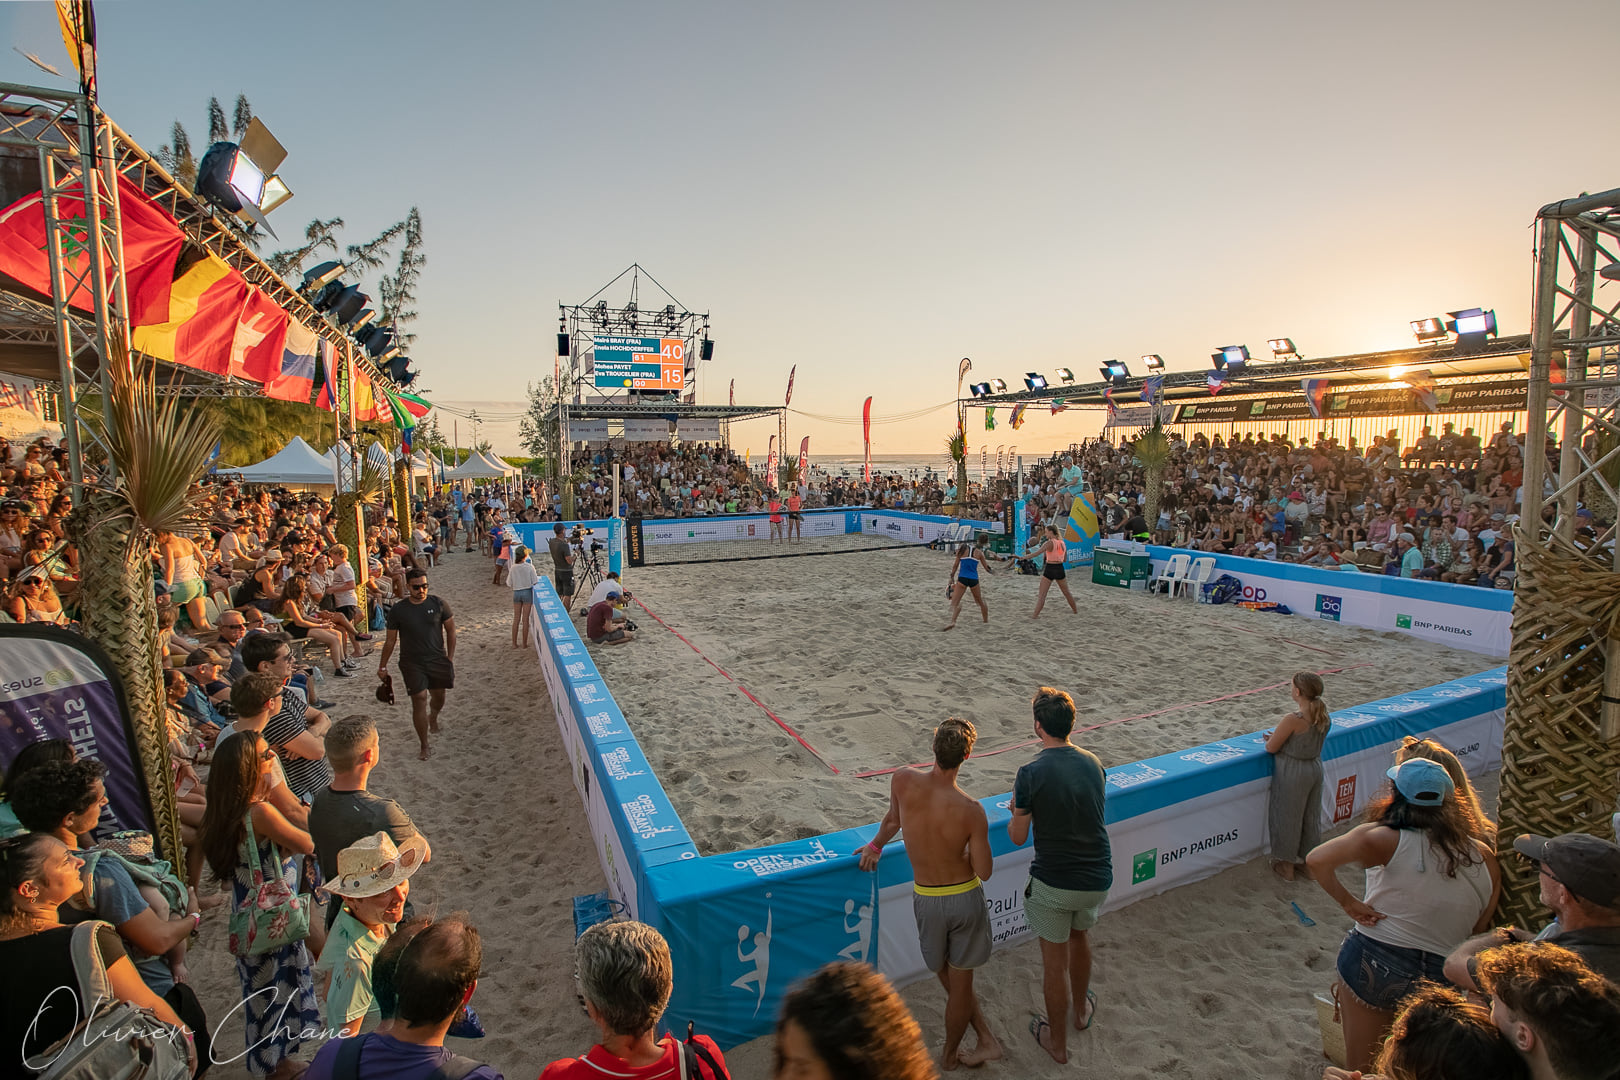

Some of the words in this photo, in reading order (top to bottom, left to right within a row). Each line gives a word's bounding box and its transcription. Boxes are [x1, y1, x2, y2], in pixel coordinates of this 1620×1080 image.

[661, 345, 683, 360] 40
[663, 369, 681, 383] 15
[1369, 394, 1409, 404] PARIBAS
[1454, 391, 1477, 399] BNP
[1478, 387, 1528, 398] PARIBAS
[631, 525, 639, 560] SANDEVER
[1069, 552, 1094, 562] BRISANT
[1414, 620, 1433, 629] BNP
[1433, 624, 1473, 637] PARIBAS
[615, 746, 632, 763] OPEN
[605, 752, 628, 781] BRISANTS
[1111, 768, 1167, 786] BRISANTS
[1340, 781, 1354, 797] TEN
[637, 794, 659, 816] OPEN
[1337, 803, 1351, 818] NIS
[627, 801, 655, 840] BRISANTS
[1160, 847, 1188, 866] BNP
[1189, 828, 1239, 856] PARIBAS
[733, 853, 784, 870] OPEN
[751, 850, 839, 874] BRISANTS
